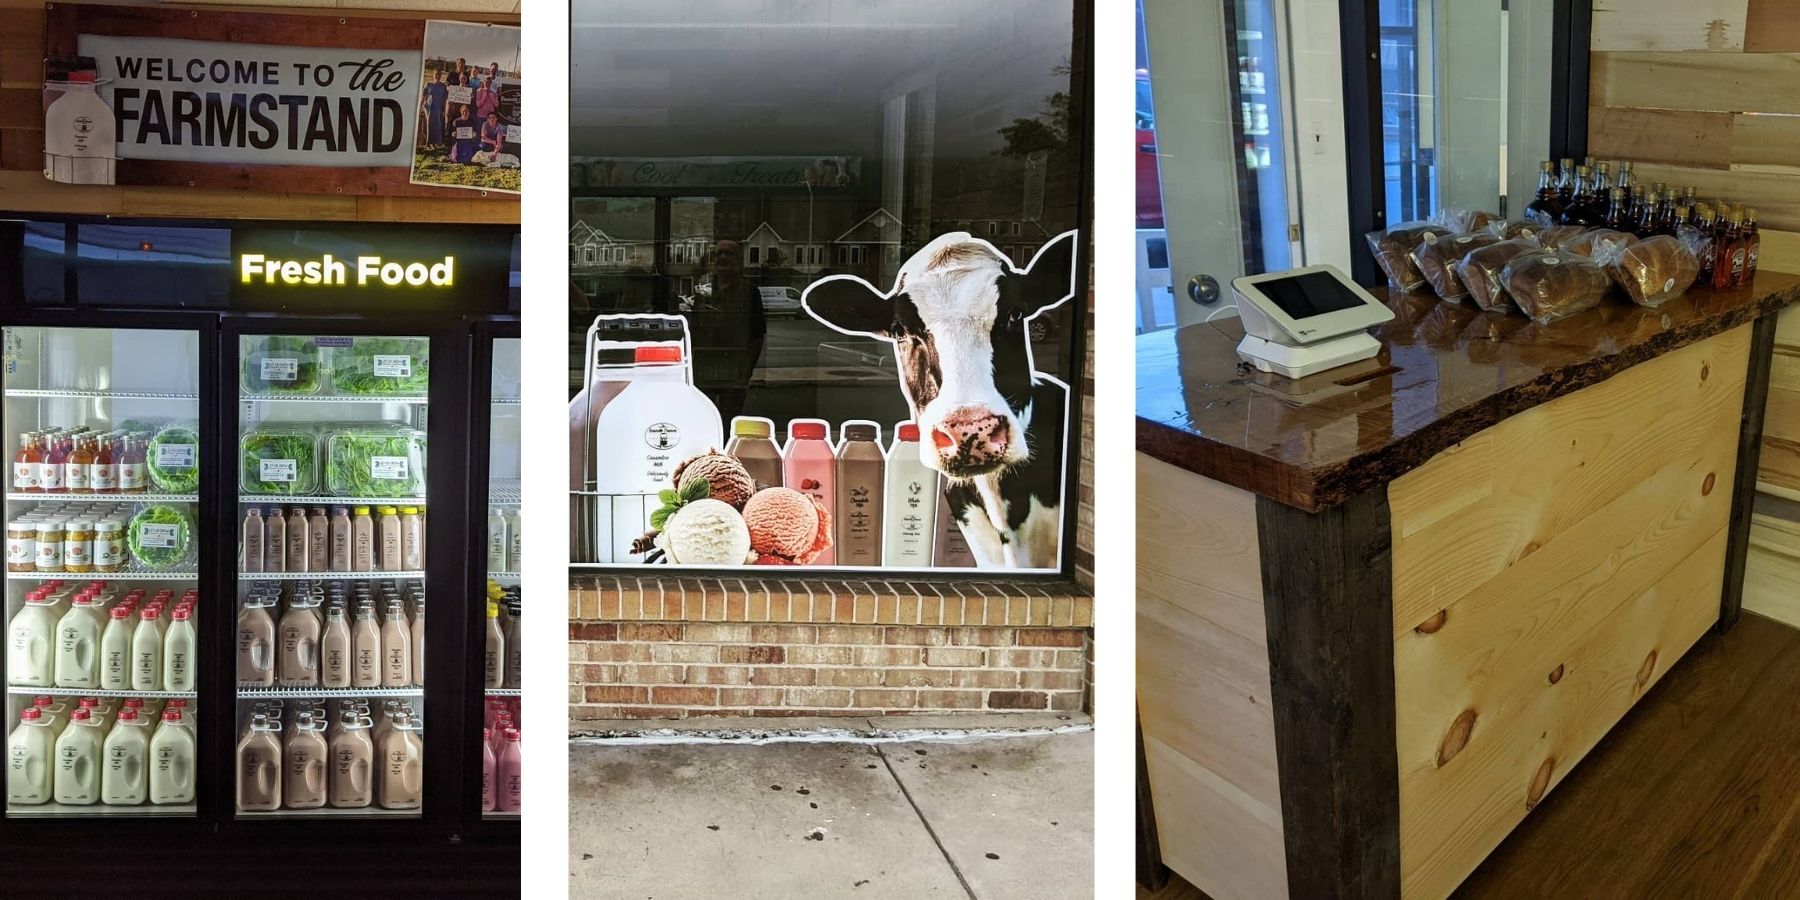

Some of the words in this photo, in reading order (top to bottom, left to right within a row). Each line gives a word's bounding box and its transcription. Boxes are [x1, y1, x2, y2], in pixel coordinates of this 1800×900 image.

[115, 56, 280, 85] WELCOME
[293, 64, 335, 87] TO
[338, 58, 407, 92] the
[113, 87, 404, 153] FARMSTAND
[632, 161, 688, 185] Cool
[730, 161, 799, 185] Treats
[241, 254, 346, 285] Fresh
[357, 256, 454, 286] Food
